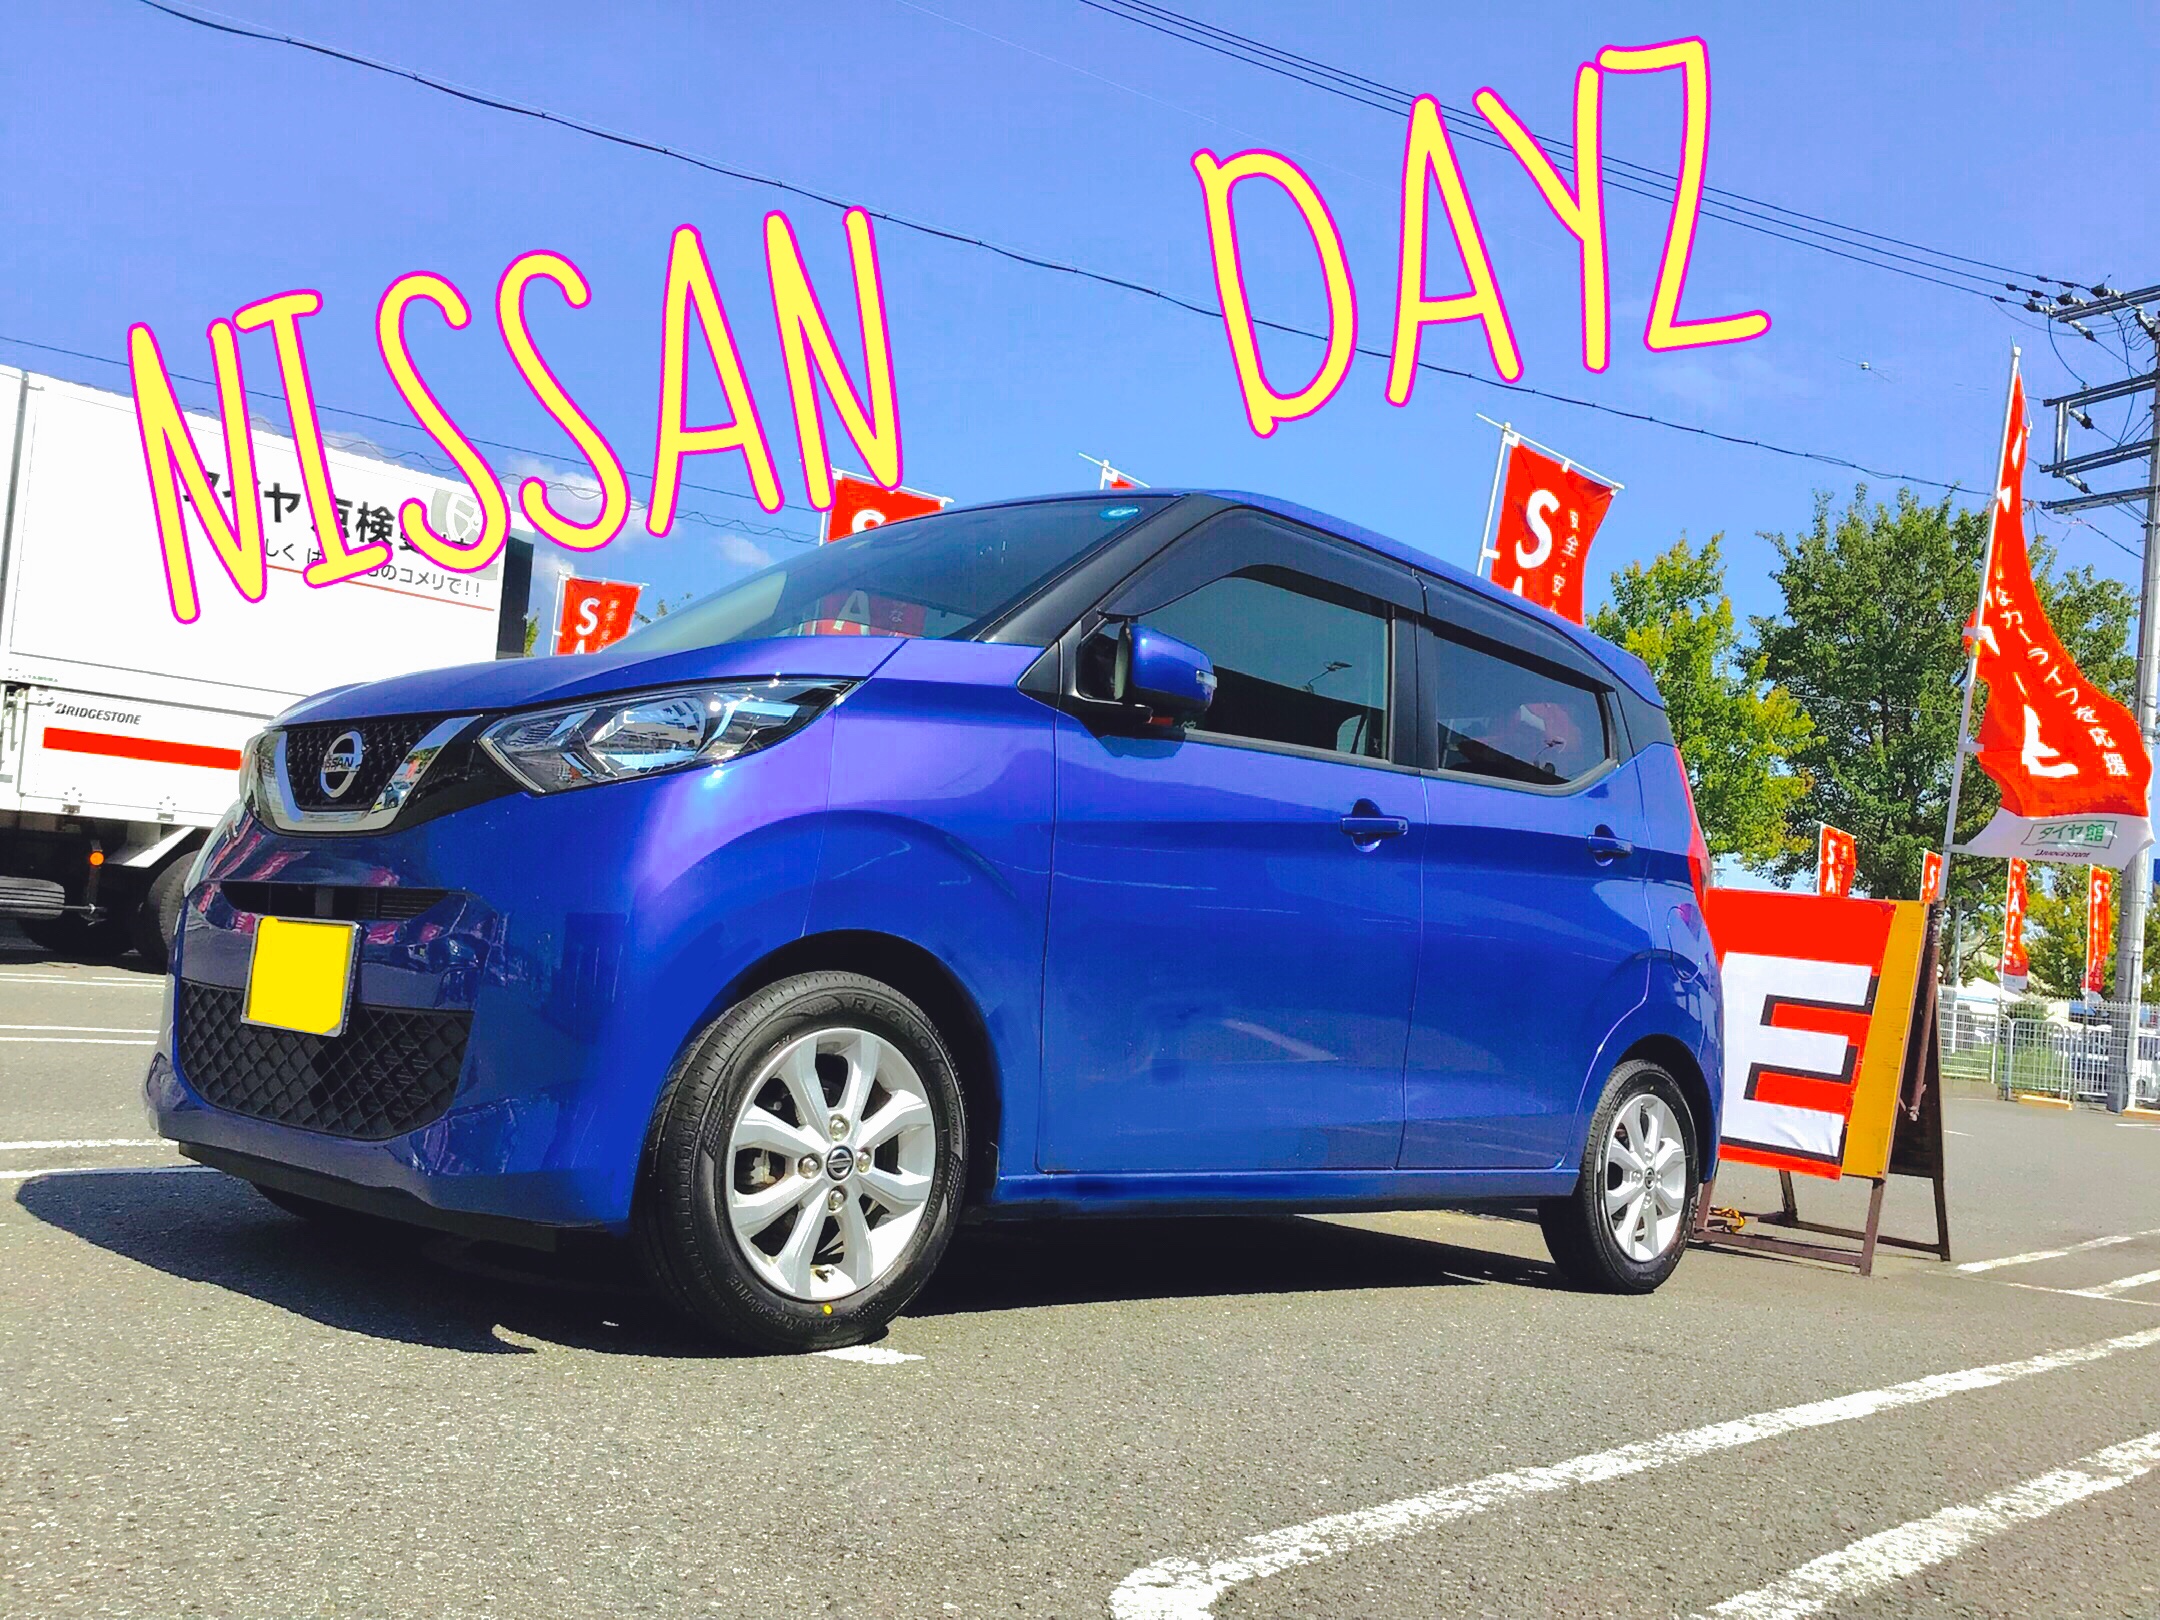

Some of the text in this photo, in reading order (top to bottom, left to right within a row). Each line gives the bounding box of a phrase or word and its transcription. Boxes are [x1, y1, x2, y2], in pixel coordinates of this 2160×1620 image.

[55, 703, 142, 725] BRIDGESTONE
[2038, 823, 2106, 842] タイヤ館
